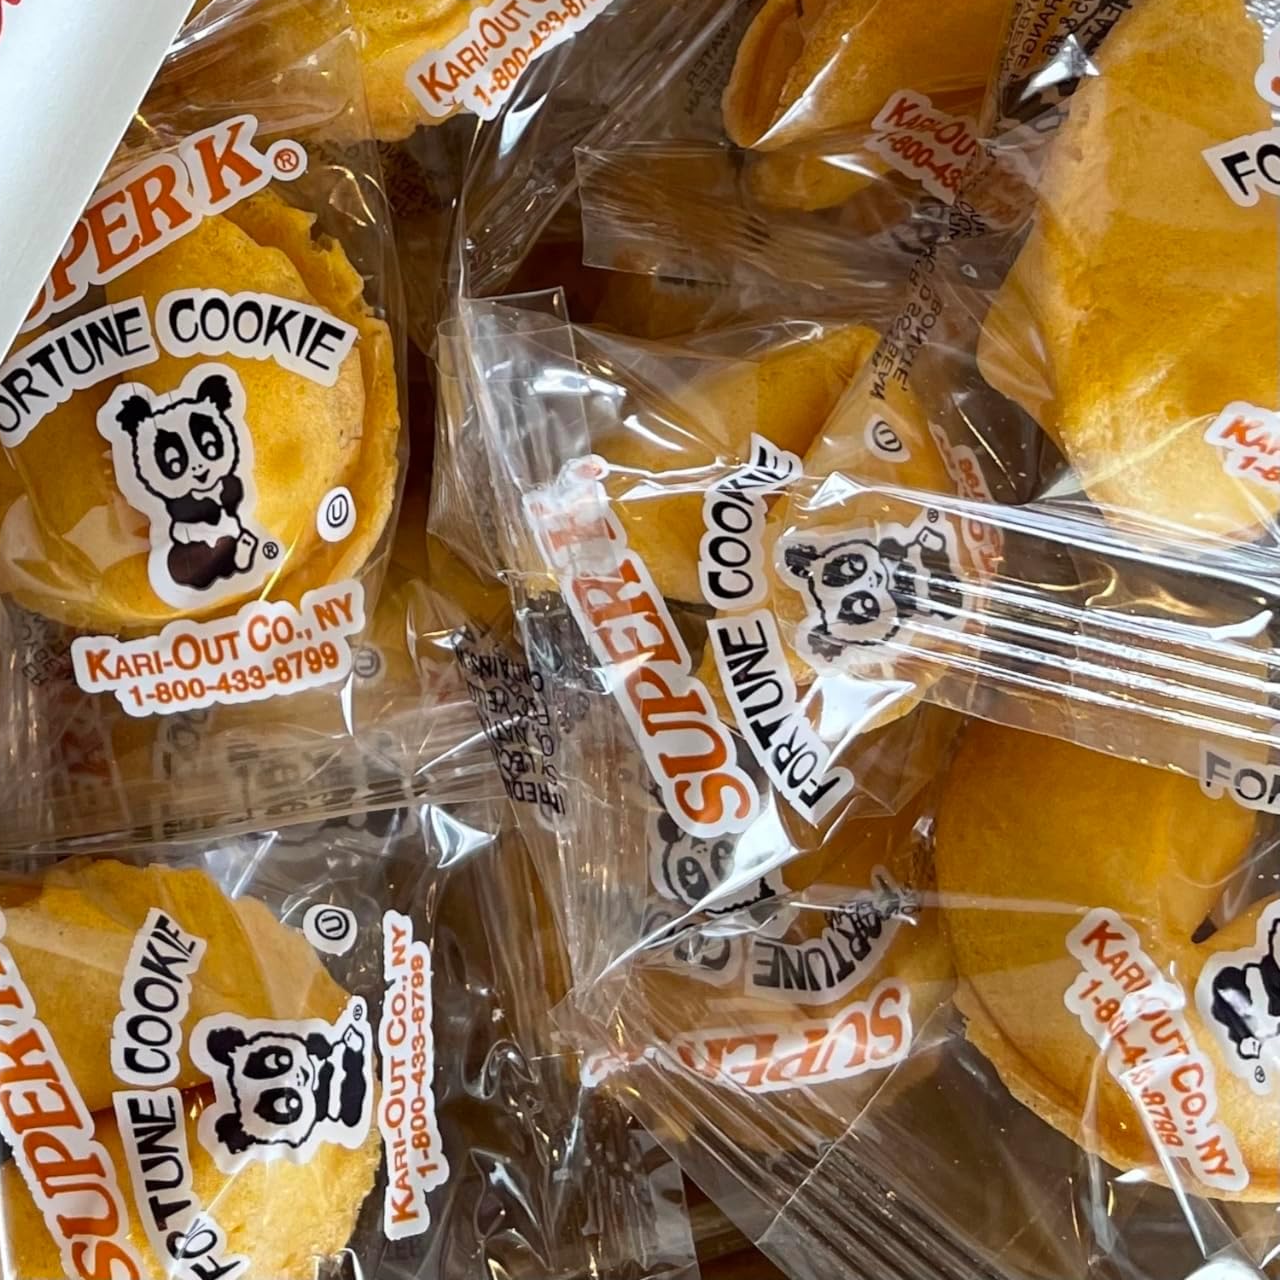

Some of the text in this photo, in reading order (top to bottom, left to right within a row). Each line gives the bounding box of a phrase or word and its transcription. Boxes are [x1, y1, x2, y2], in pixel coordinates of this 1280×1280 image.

[418, 0, 531, 104] KARI-OUT
[196, 123, 263, 207] K
[170, 299, 346, 370] COOKIE
[86, 631, 241, 683] KARI-OUT
[317, 593, 357, 628] NY
[128, 642, 340, 708] 1-800-433-8799
[707, 447, 840, 809] FORTUNE COOKIE
[573, 565, 750, 824] SUPER
[124, 916, 197, 1074] COOKIE
[391, 926, 407, 965] NY
[408, 956, 438, 1180] 1-800-433-8799
[1082, 920, 1189, 1057] KARIOUT
[1196, 1135, 1236, 1177] NY
[384, 1060, 417, 1223] KARI-OUT
